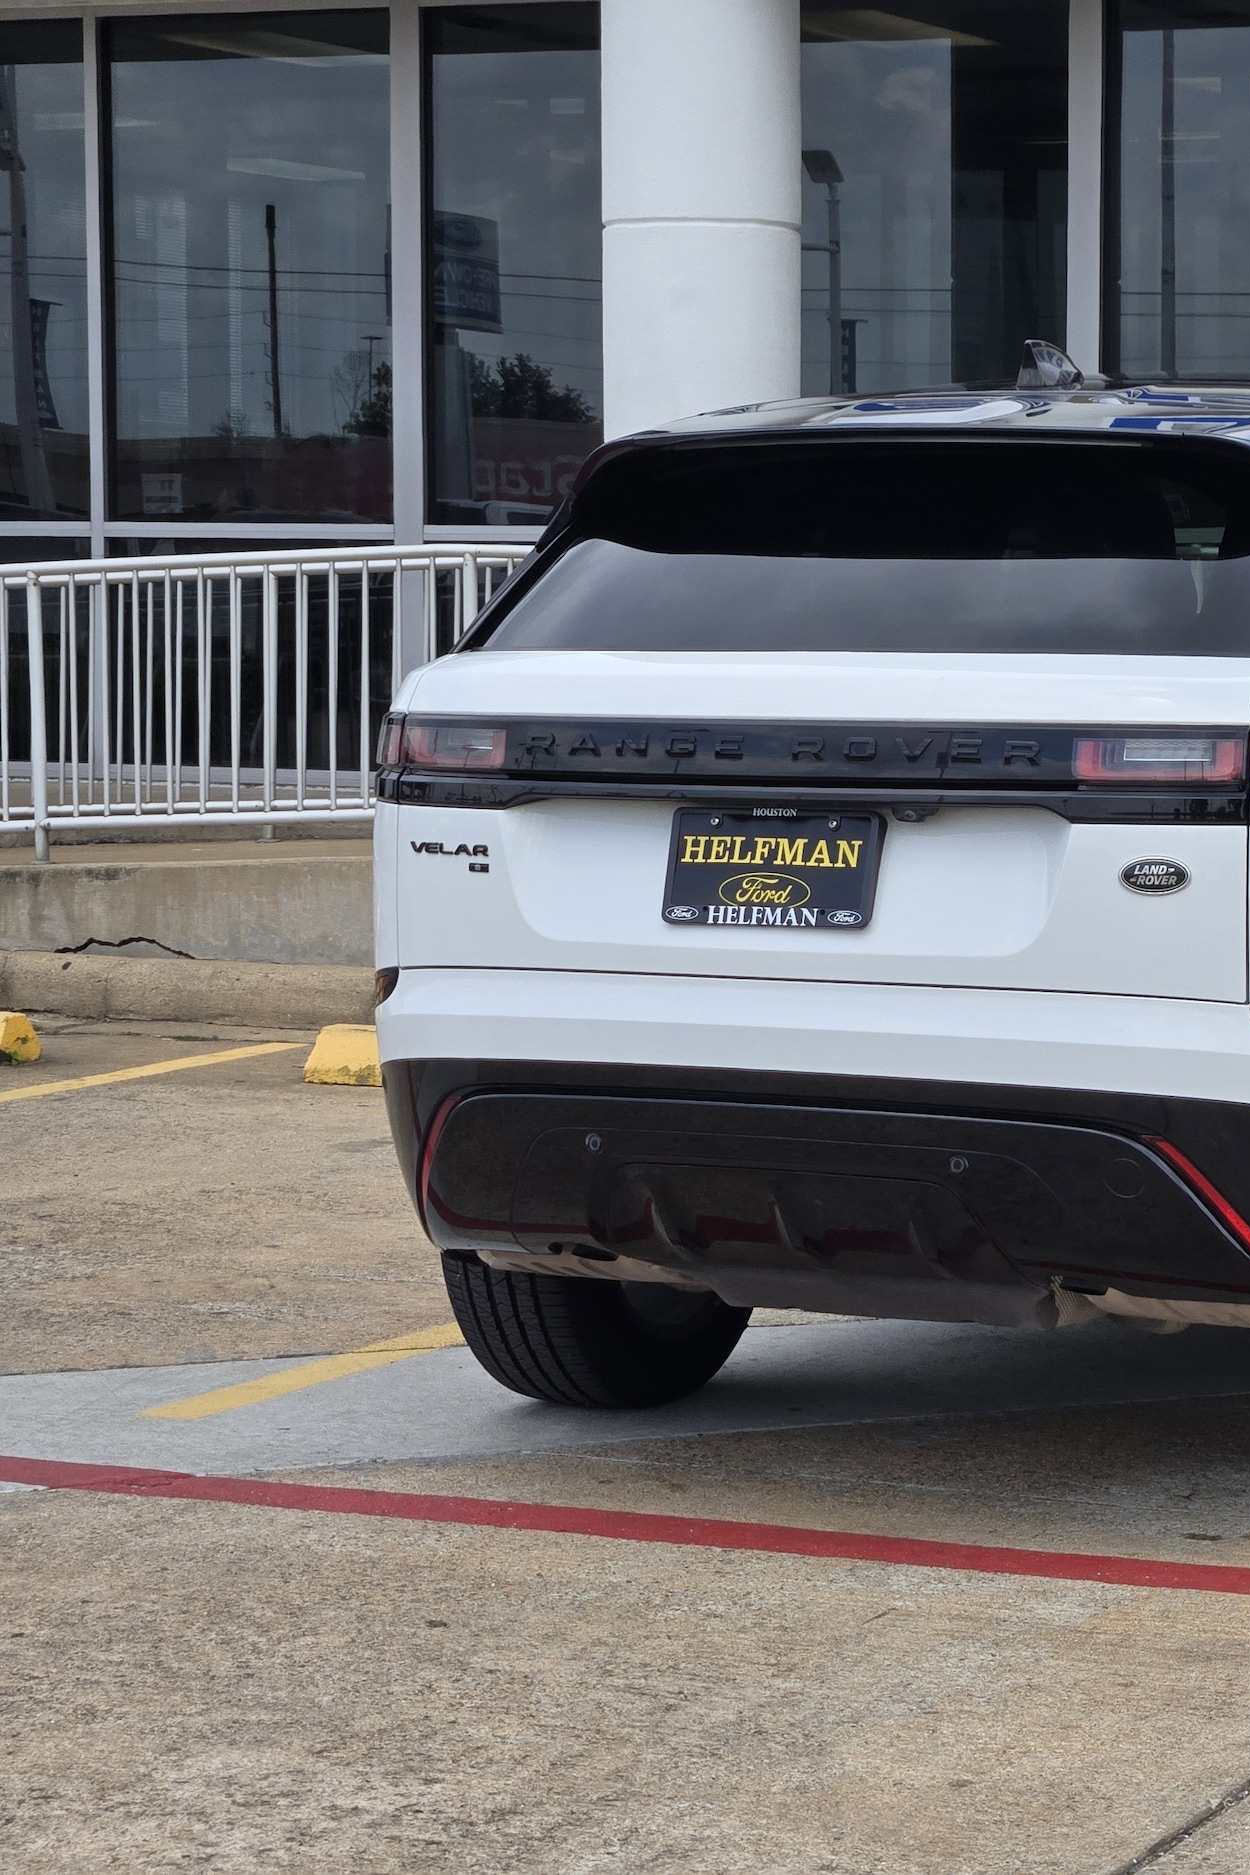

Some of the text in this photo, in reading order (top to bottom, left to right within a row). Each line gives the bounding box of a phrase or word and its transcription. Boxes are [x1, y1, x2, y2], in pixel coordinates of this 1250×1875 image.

[526, 733, 1041, 766] RANGE ROVER
[752, 807, 798, 818] HOUSTON
[410, 841, 489, 857] VELAR
[681, 835, 863, 868] HELFMAN
[1133, 865, 1168, 875] LAND
[735, 875, 793, 904] Ford
[1136, 875, 1178, 886] ROVER
[706, 905, 819, 927] HELFMAN
